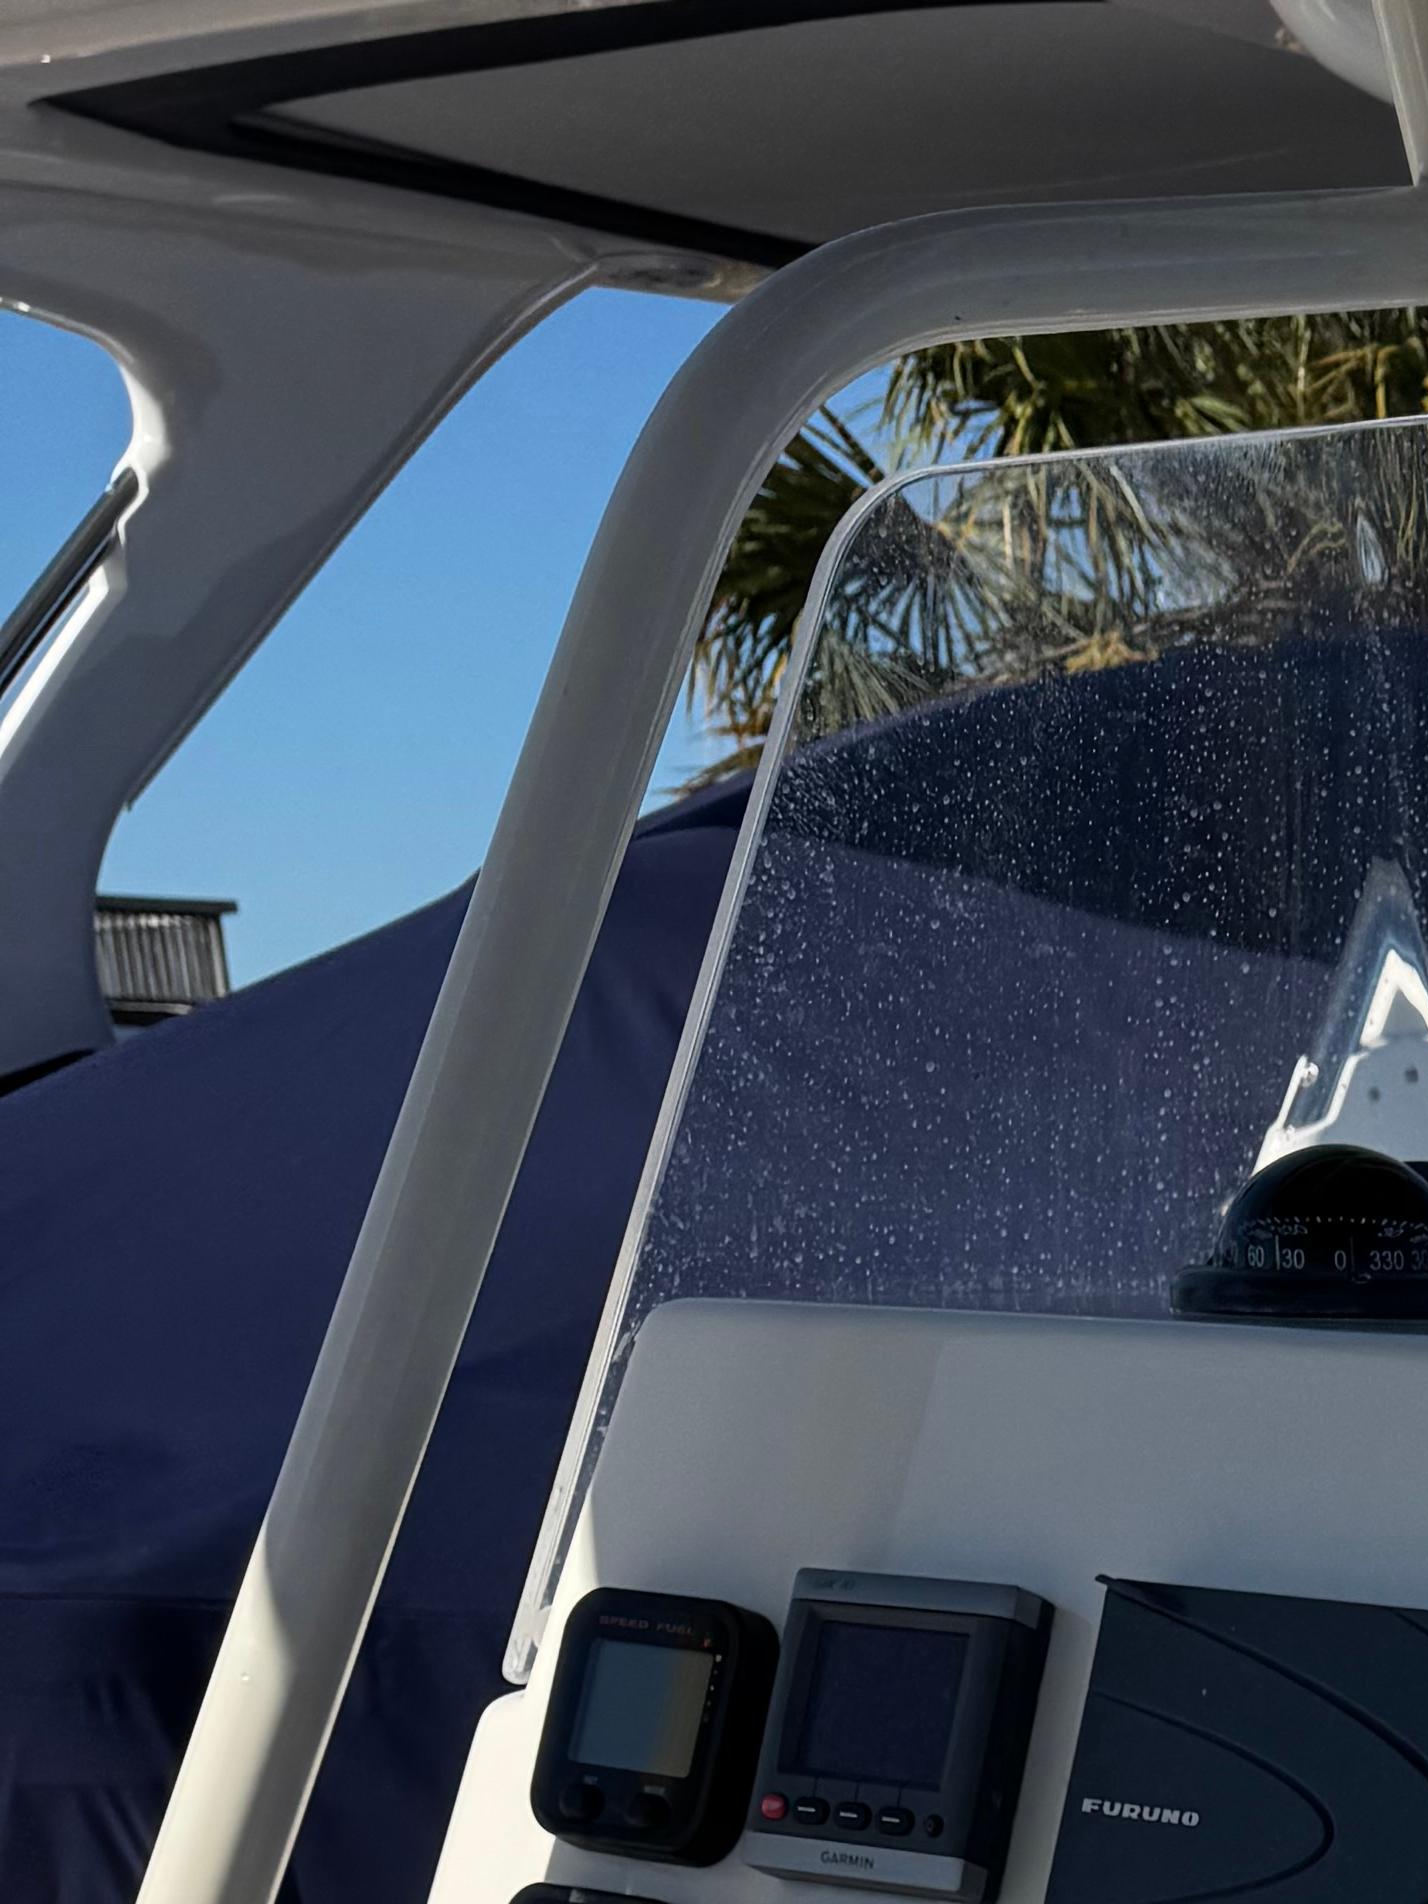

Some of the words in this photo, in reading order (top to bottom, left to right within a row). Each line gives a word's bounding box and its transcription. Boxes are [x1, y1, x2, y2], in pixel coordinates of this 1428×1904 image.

[1247, 1244, 1266, 1269] 60
[1281, 1247, 1305, 1272] 30
[1333, 1248, 1348, 1271] 0
[1368, 1249, 1404, 1272] 330
[1080, 1797, 1200, 1828] FURUNO
[820, 1849, 876, 1871] GARMIN
